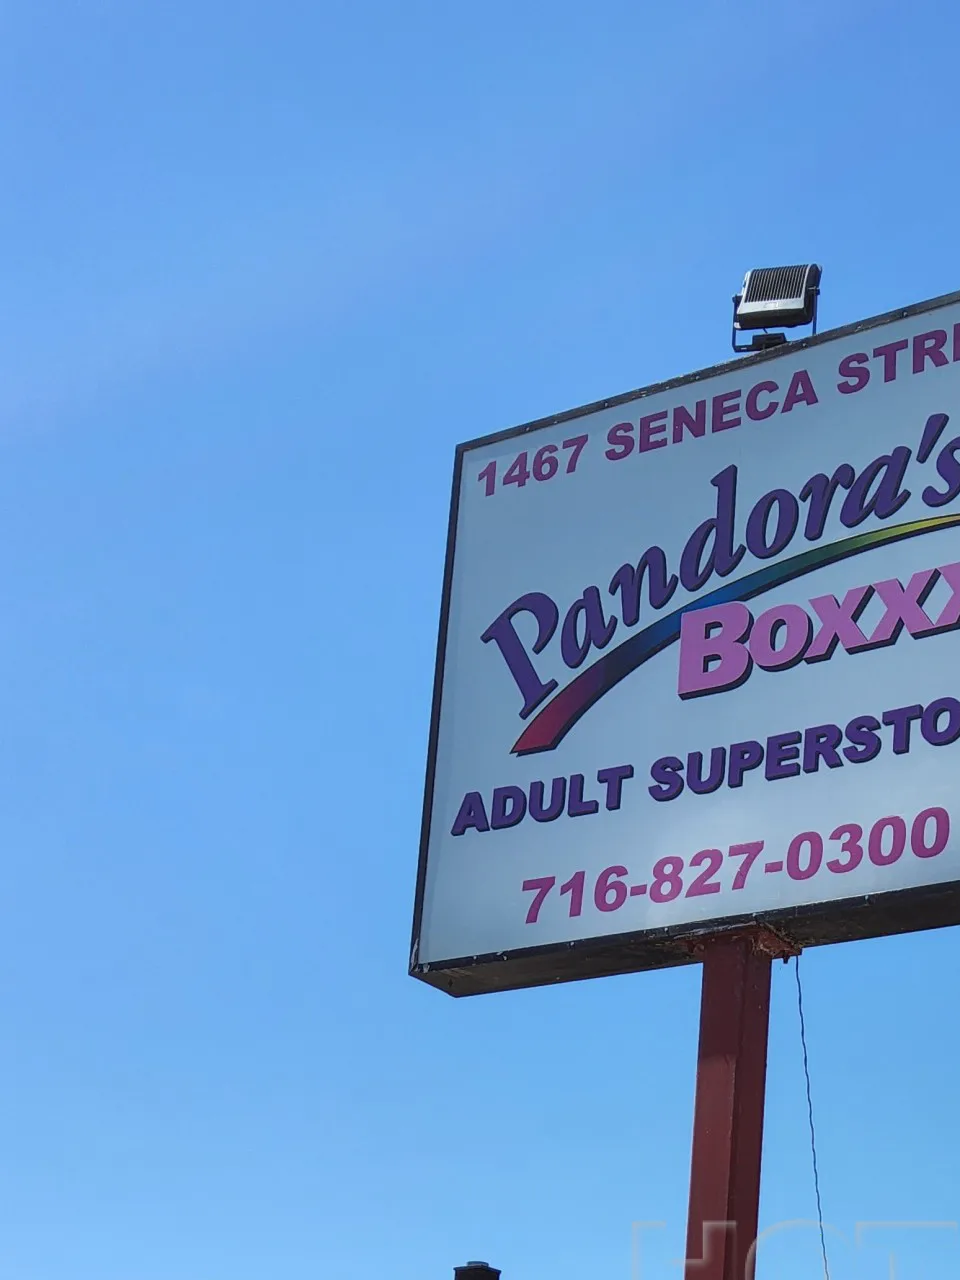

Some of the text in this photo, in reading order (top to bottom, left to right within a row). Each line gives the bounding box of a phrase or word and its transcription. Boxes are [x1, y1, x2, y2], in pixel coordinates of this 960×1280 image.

[477, 435, 589, 497] 1467
[605, 370, 819, 462] SENECA
[451, 764, 633, 836] ADULT
[522, 806, 950, 924] 716-827-0300
